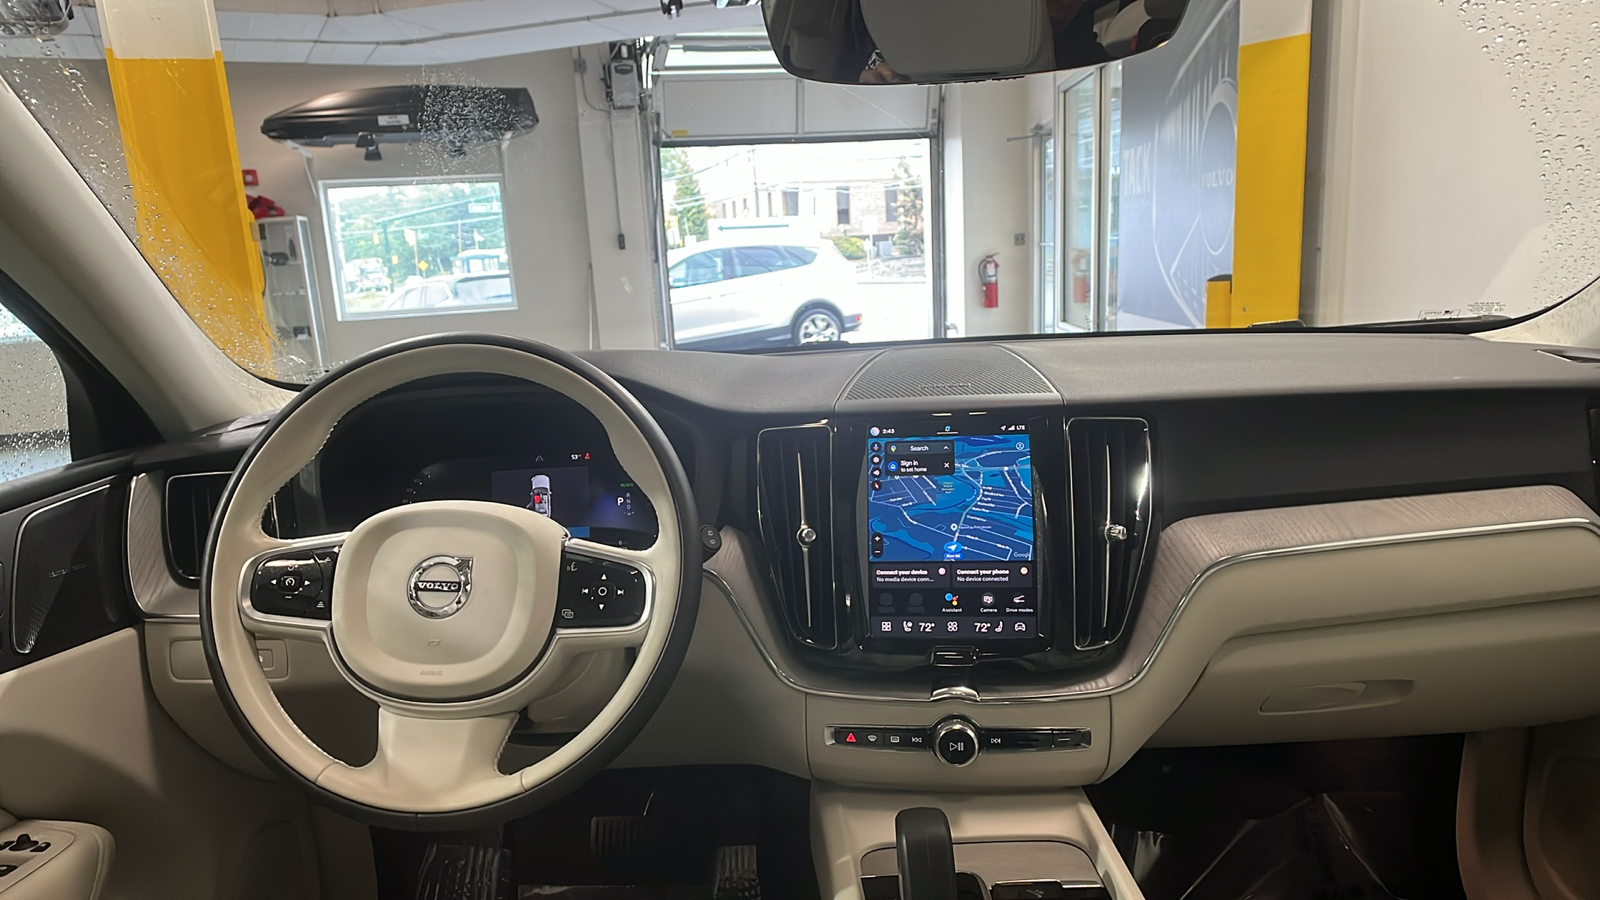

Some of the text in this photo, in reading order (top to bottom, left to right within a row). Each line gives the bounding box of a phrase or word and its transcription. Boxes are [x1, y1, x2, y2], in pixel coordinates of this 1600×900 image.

[1201, 168, 1233, 188] VOLVO
[617, 497, 624, 506] P
[417, 582, 459, 591] VOLVO
[919, 622, 935, 632] 72°
[974, 622, 991, 632] 72°
